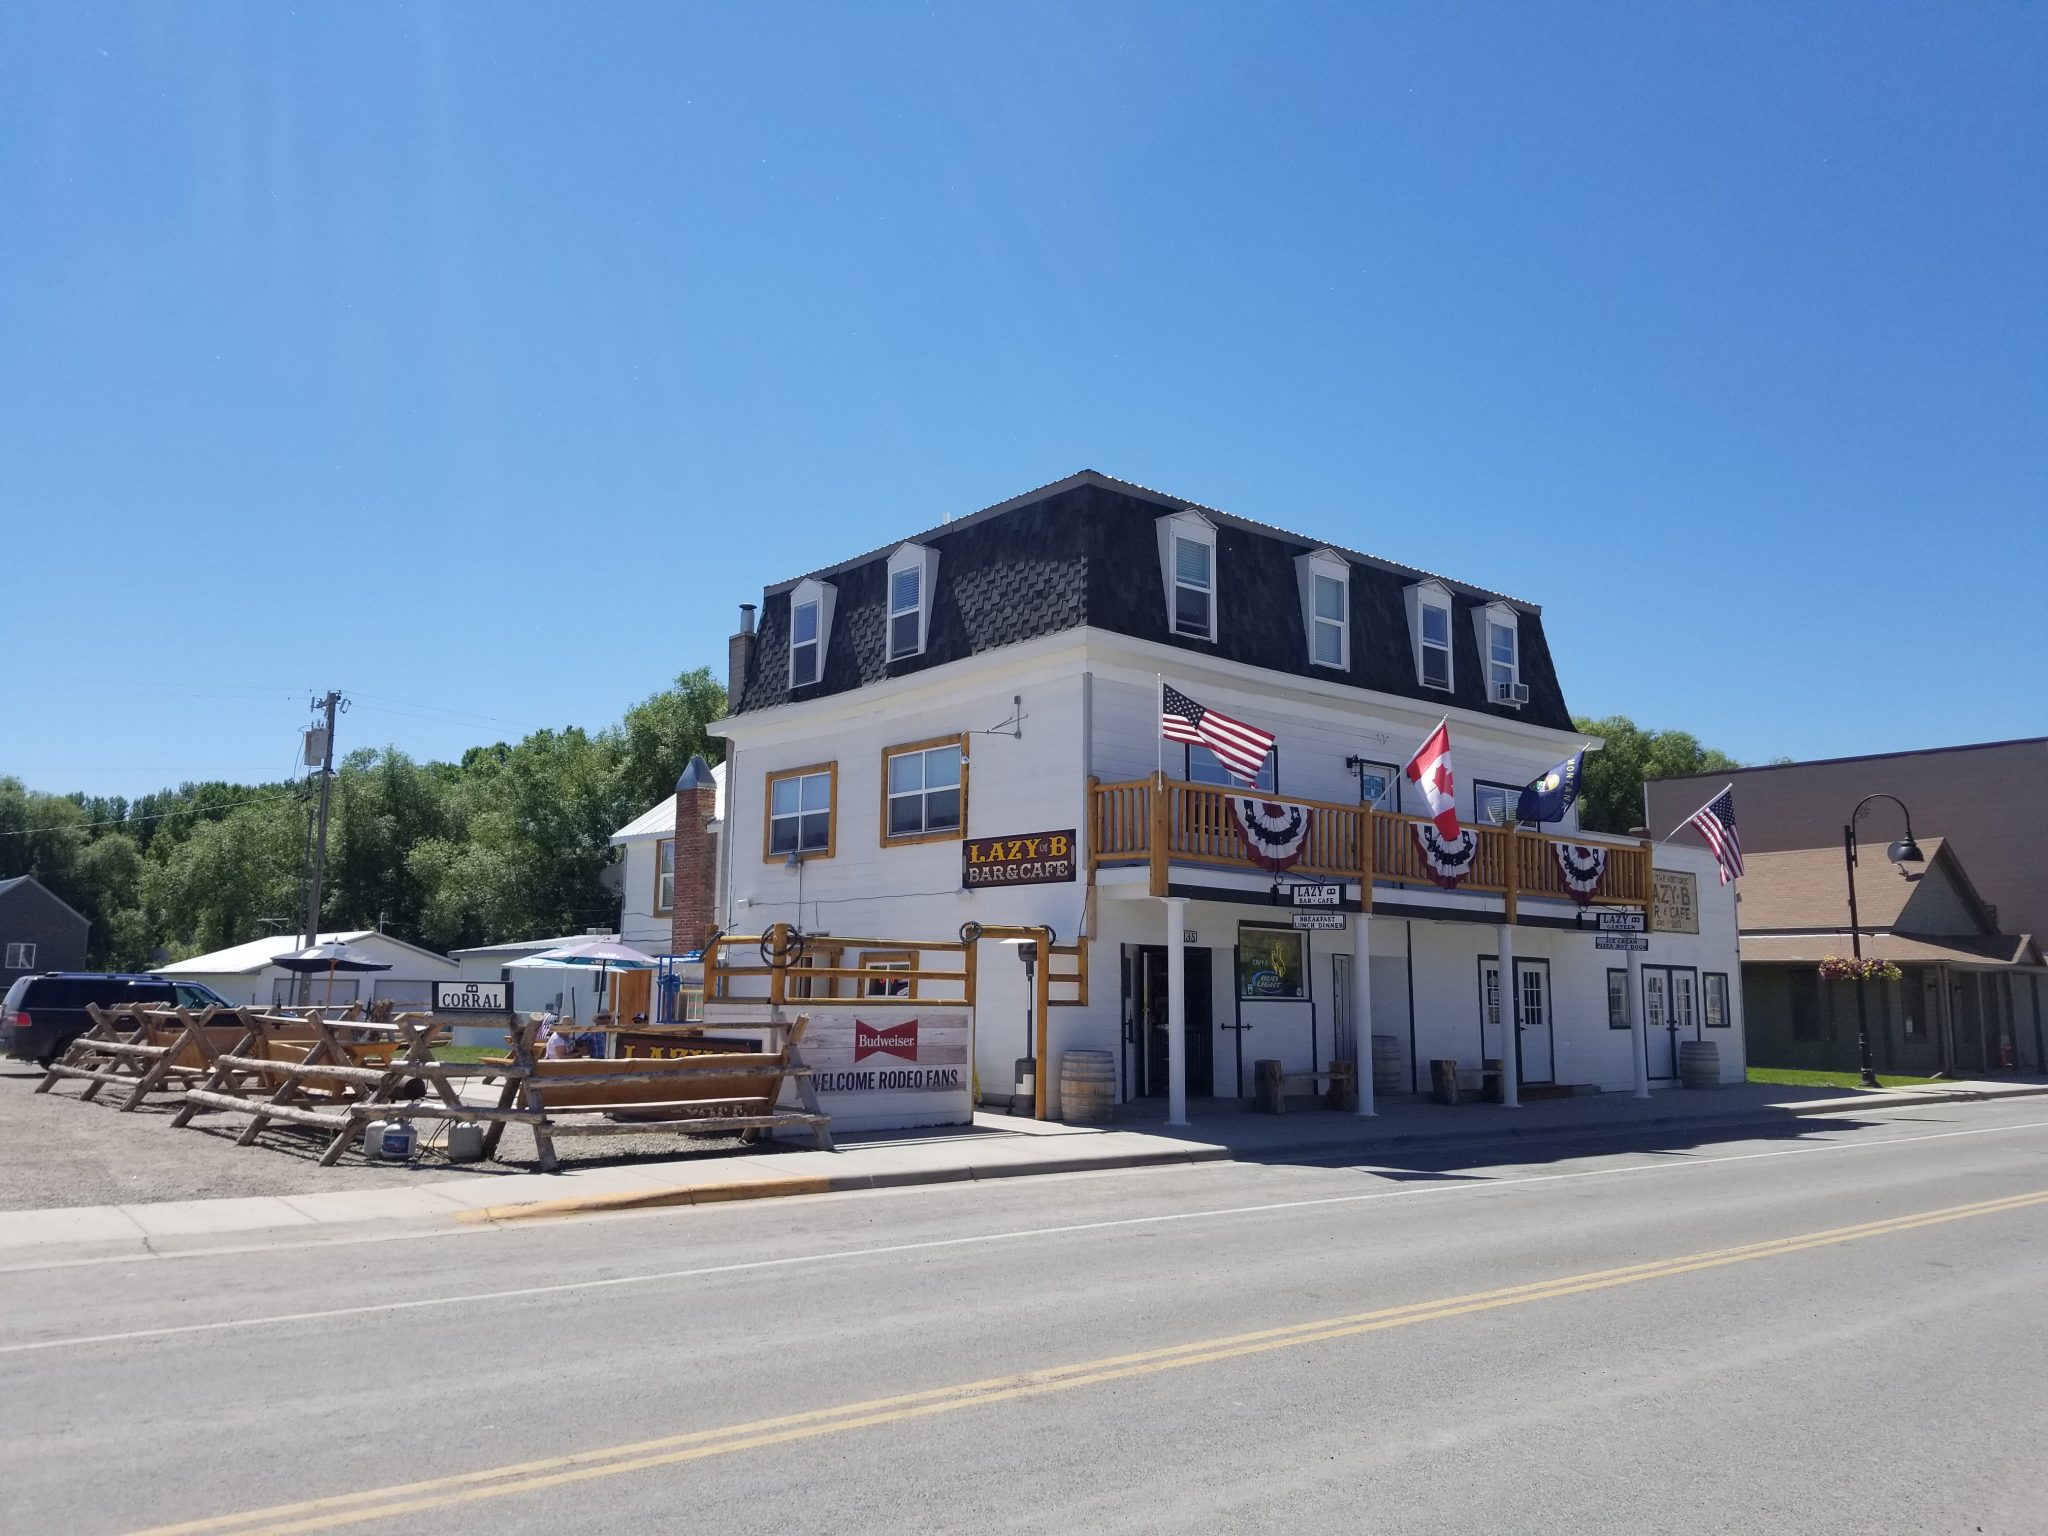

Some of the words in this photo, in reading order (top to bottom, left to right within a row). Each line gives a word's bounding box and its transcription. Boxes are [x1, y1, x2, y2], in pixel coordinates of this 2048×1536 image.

[1562, 758, 1576, 813] MONTANA
[969, 838, 1042, 864] LAZY
[1049, 836, 1067, 857] B
[1297, 886, 1324, 897] LAZY
[1653, 883, 1677, 904] AZY
[1602, 914, 1629, 924] LAZY
[1669, 906, 1691, 921] CAFE
[442, 993, 502, 1008] CORRAL
[858, 1034, 915, 1047] Budweiser
[809, 1071, 875, 1092] WELCOME
[878, 1070, 923, 1090] RODEO
[926, 1068, 958, 1088] FANS
